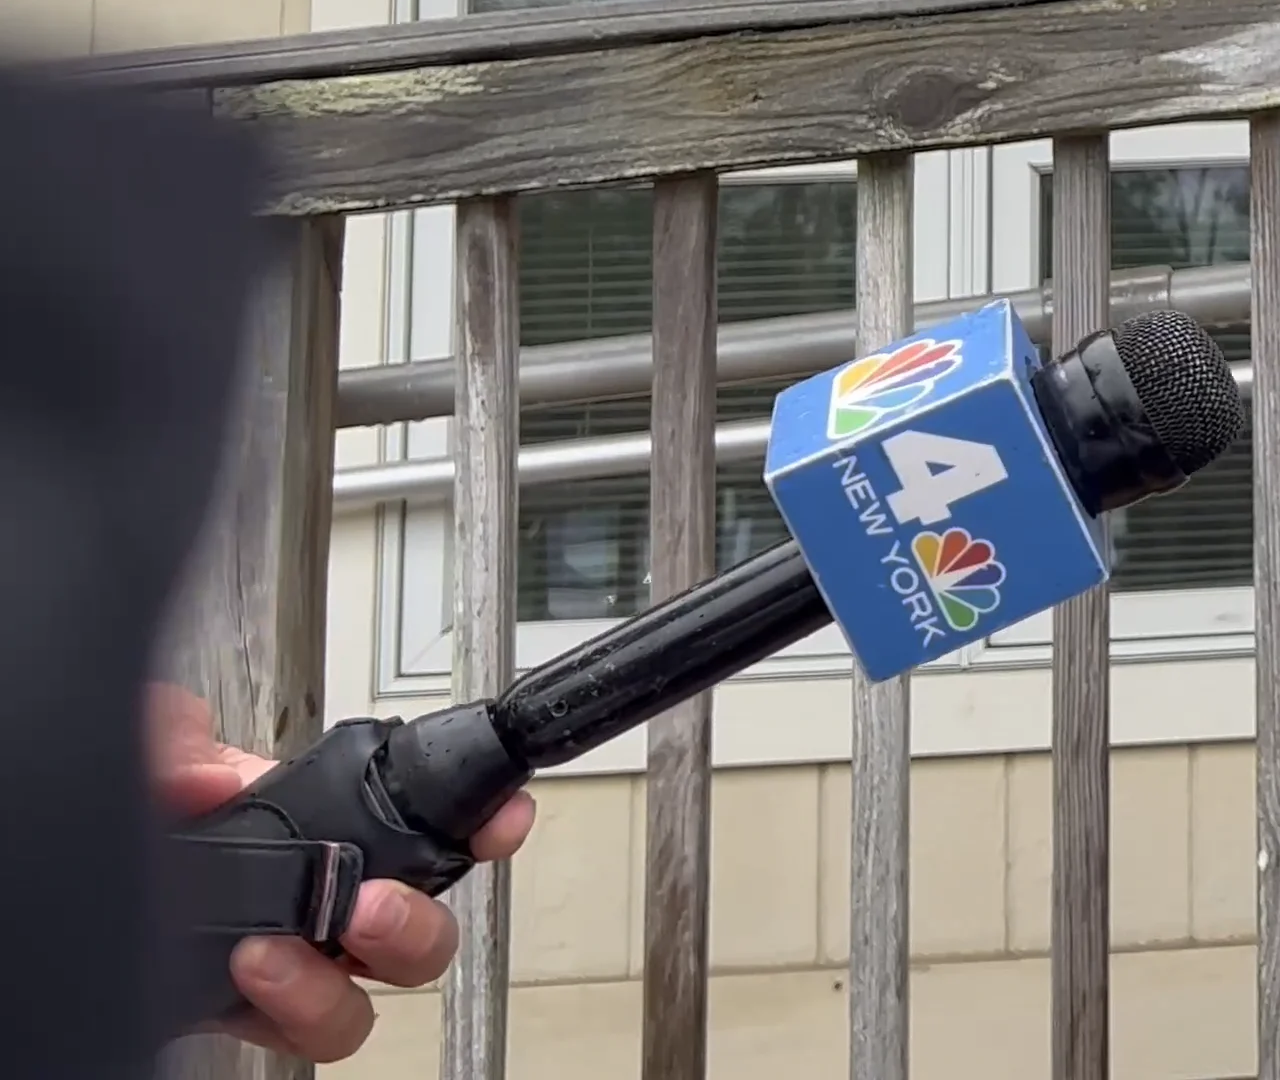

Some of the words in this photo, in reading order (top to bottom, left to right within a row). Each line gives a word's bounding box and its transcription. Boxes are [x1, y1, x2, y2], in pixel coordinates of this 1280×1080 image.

[880, 429, 1009, 526] 4
[833, 455, 893, 537] NEW
[880, 541, 946, 648] YORK
